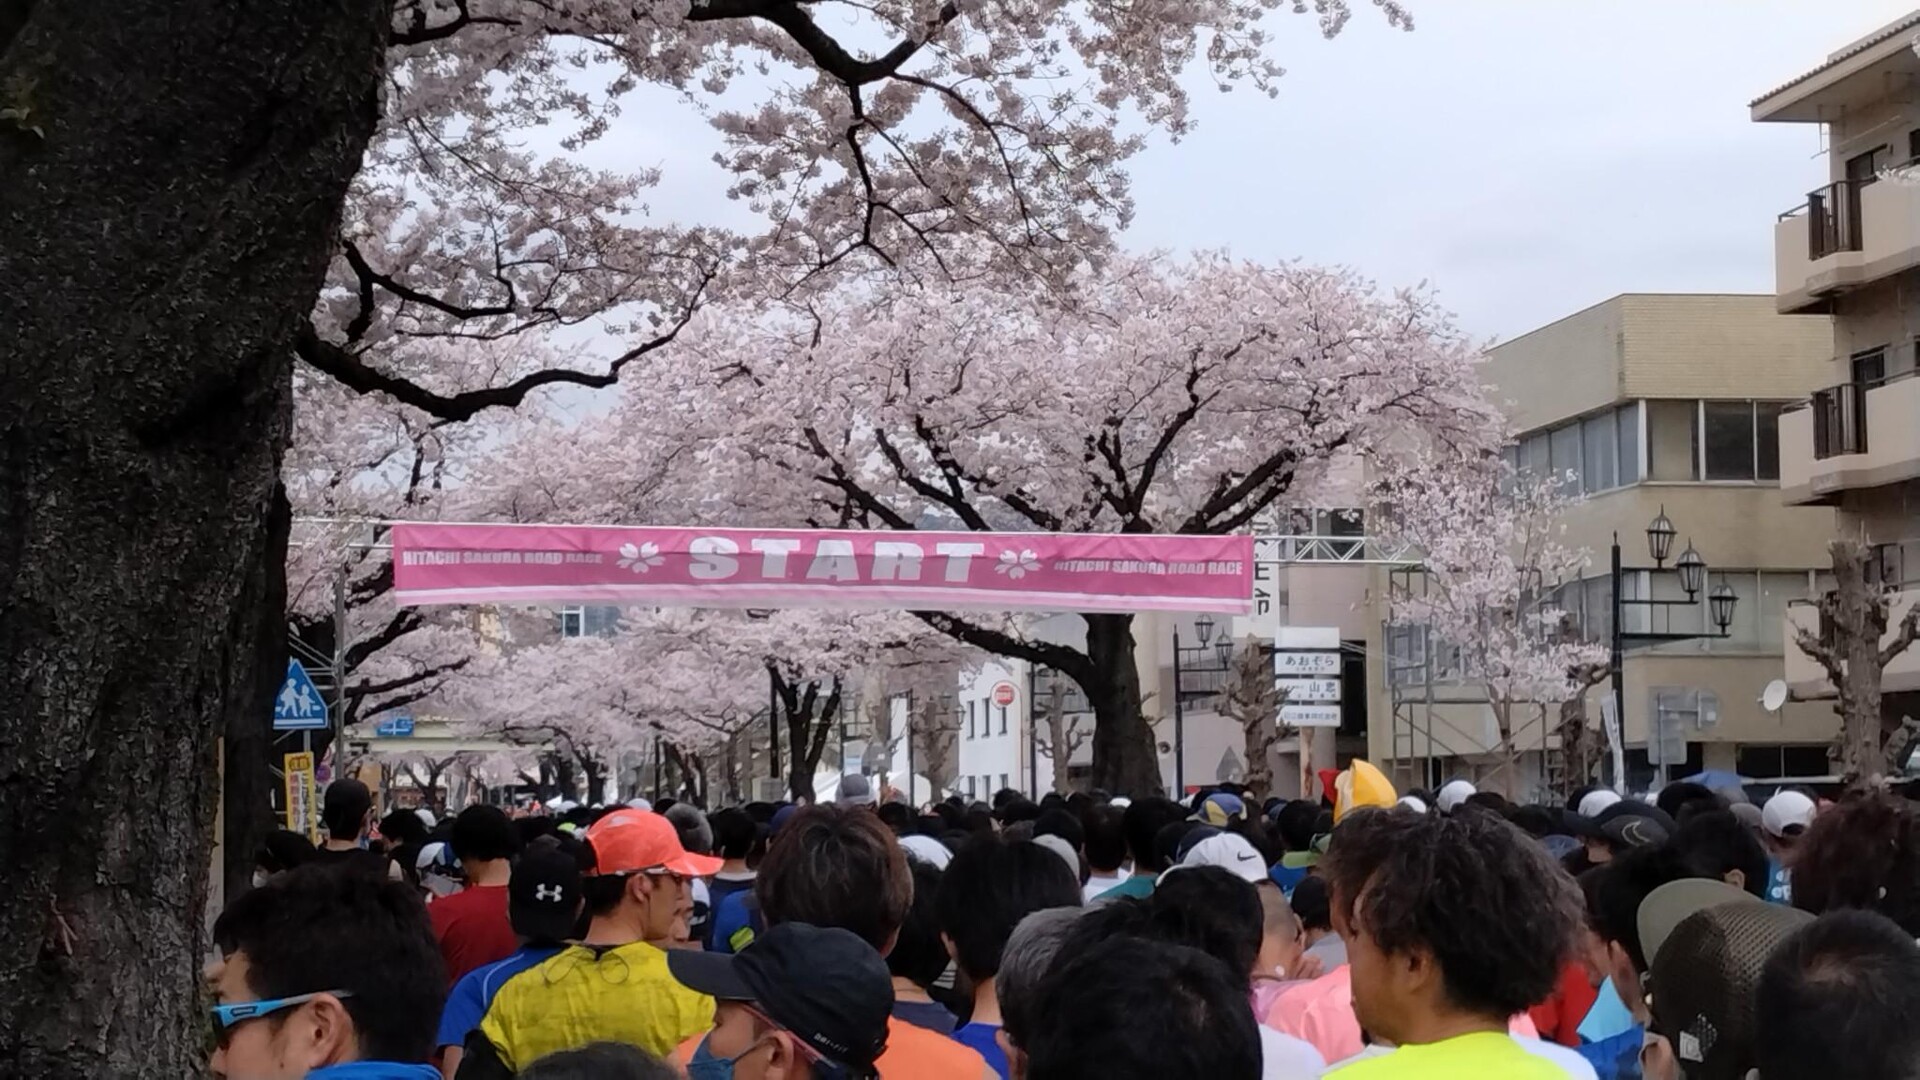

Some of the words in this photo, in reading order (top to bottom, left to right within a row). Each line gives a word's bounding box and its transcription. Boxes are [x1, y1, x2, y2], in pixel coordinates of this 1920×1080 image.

[402, 550, 461, 566] HITACHI
[463, 551, 522, 565] SAKURA
[524, 551, 563, 565] ROAD
[564, 552, 603, 565] RACE
[688, 536, 985, 583] START
[1053, 559, 1109, 573] HITACHI
[1111, 560, 1166, 576] SAKURA
[1167, 561, 1206, 575] ROAD
[1207, 562, 1243, 576] RACE
[1285, 655, 1335, 667] あおぞら
